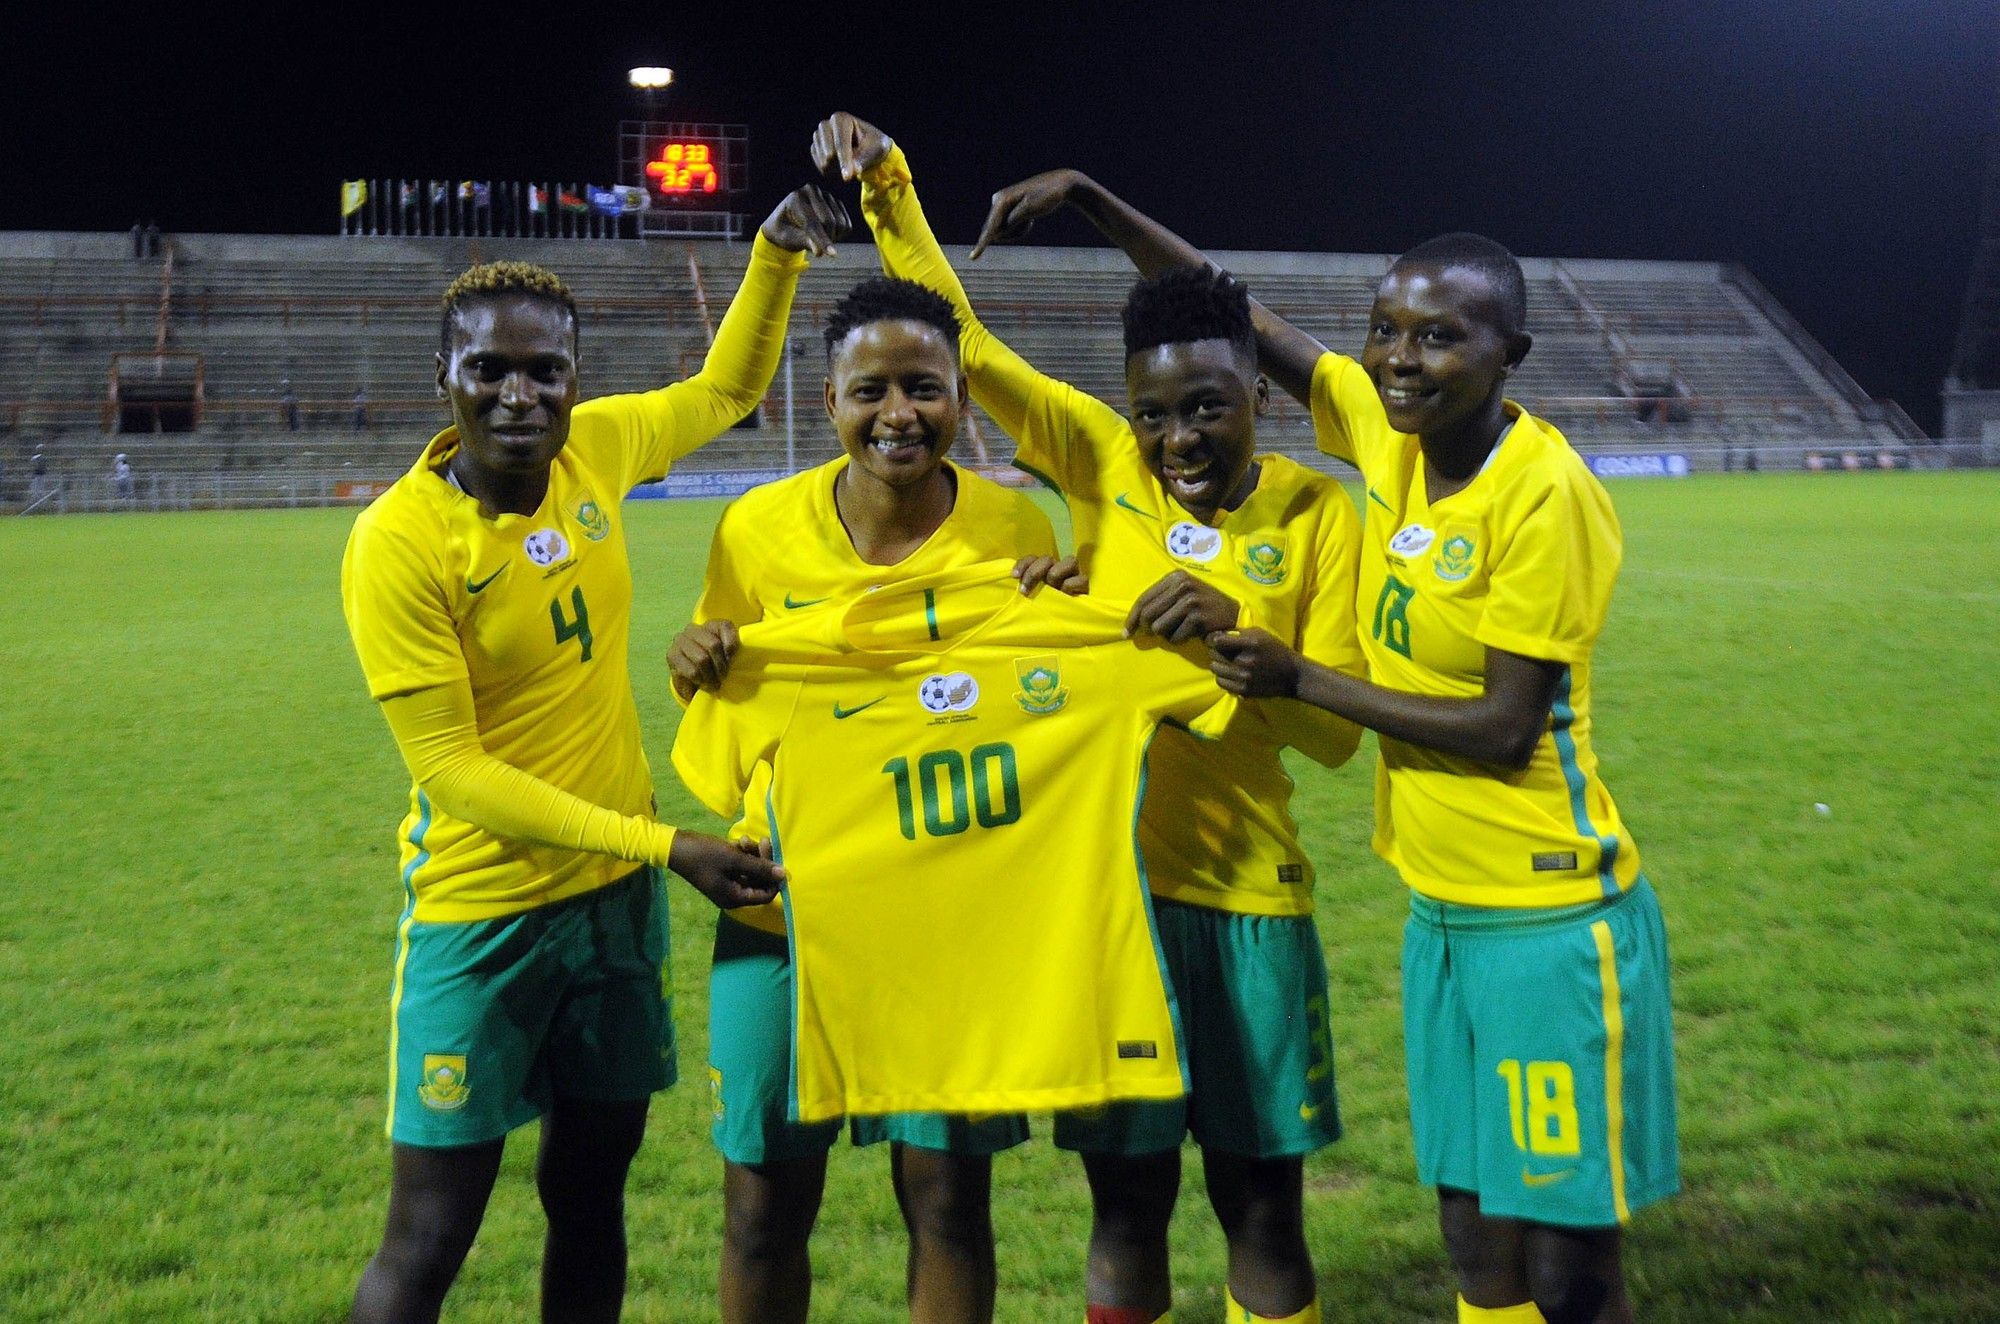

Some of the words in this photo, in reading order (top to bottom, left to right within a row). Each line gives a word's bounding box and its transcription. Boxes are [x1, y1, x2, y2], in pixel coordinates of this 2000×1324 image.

[550, 584, 593, 664] 4
[881, 741, 1022, 841] 100
[1496, 1058, 1582, 1157] 18
